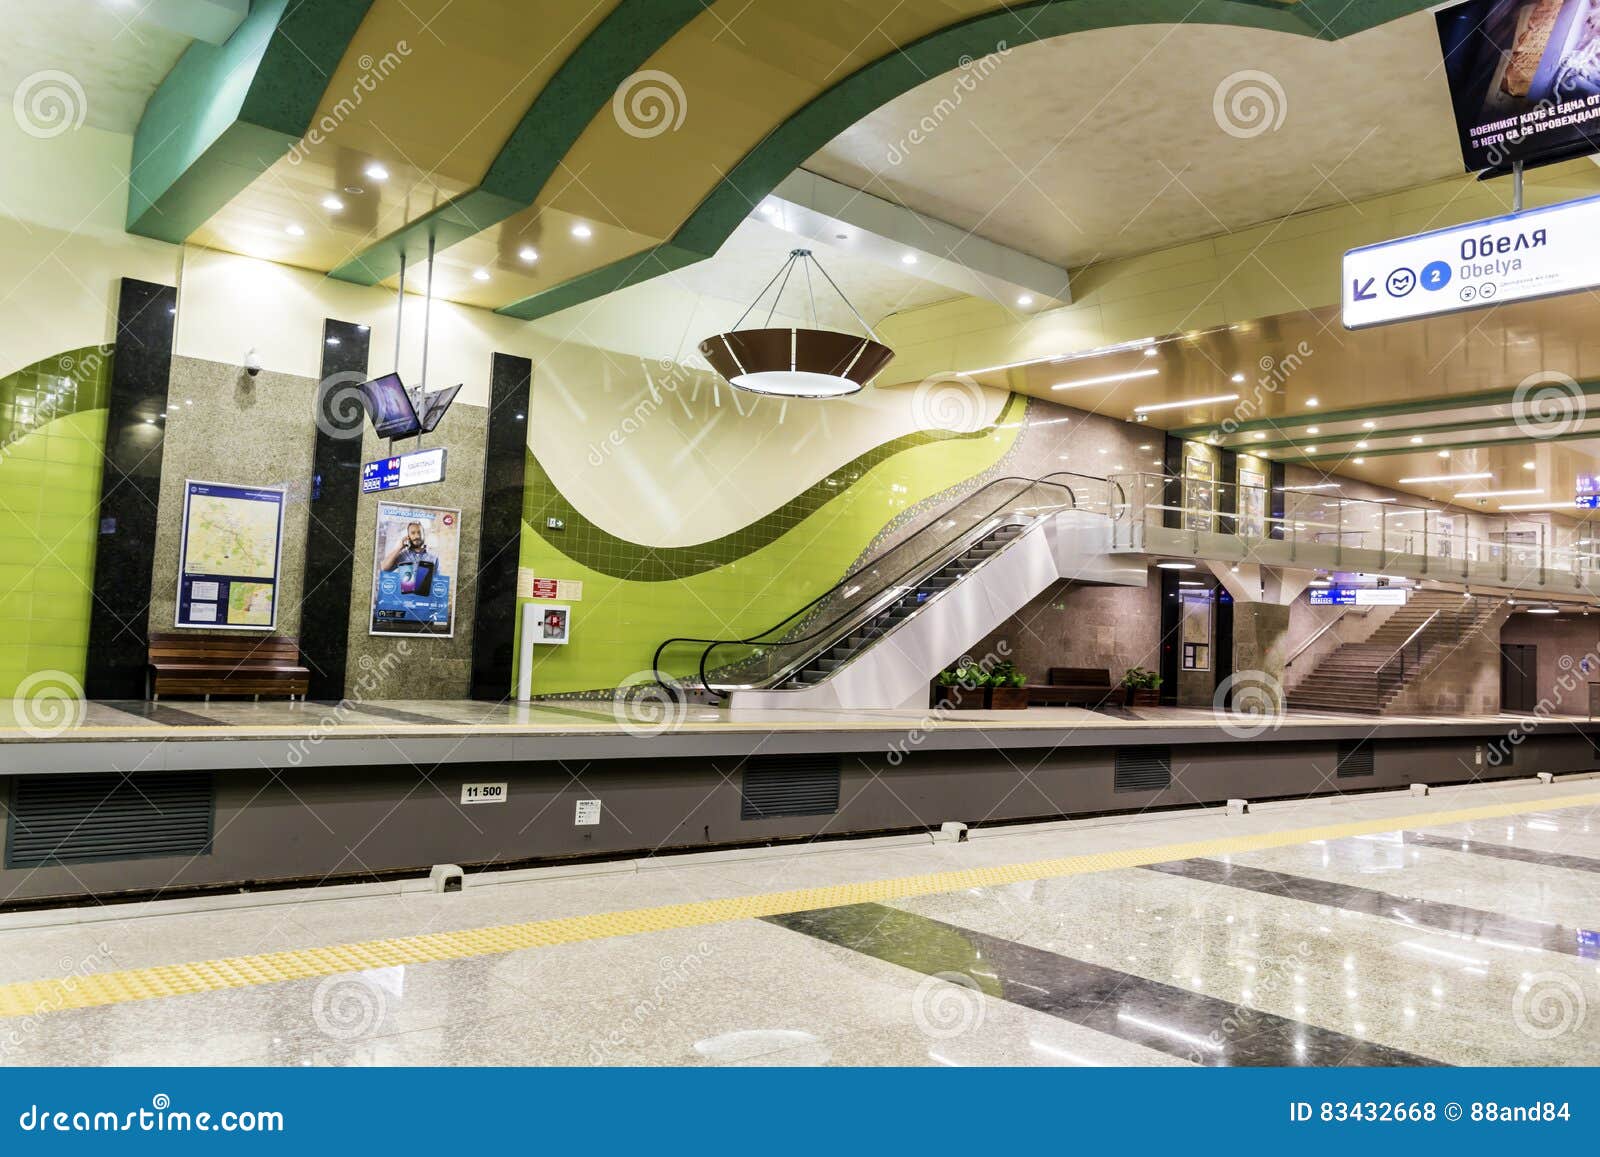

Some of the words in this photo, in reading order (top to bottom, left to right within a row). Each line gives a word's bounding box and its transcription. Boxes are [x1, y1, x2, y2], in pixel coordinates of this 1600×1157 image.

[1519, 109, 1547, 124] КЛУБ
[1557, 99, 1586, 114] ЕДНА
[1472, 140, 1480, 149] В
[1481, 134, 1505, 147] НЕГО
[1506, 129, 1520, 141] СА
[1521, 126, 1535, 137] СЕ
[1535, 107, 1600, 133] ПРОВЕЖДАЛ
[1460, 228, 1547, 261] Обеля
[1430, 270, 1441, 283] 2
[1460, 257, 1522, 280] Obelya
